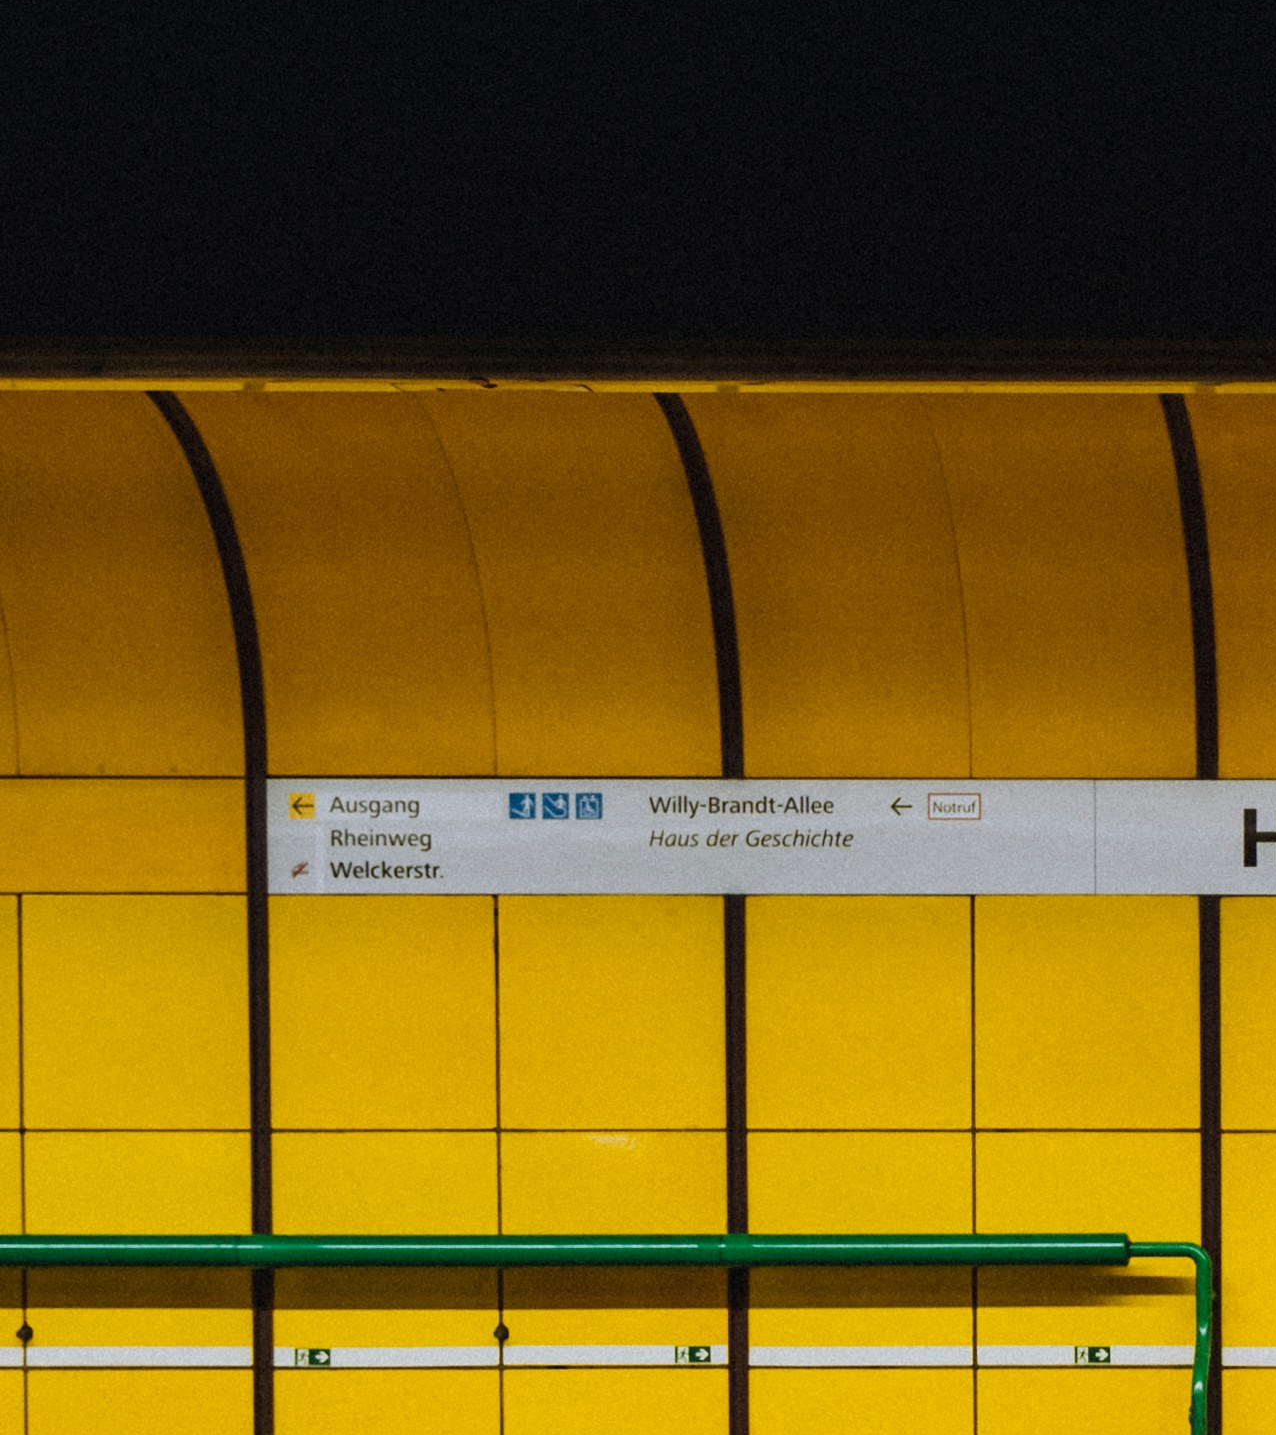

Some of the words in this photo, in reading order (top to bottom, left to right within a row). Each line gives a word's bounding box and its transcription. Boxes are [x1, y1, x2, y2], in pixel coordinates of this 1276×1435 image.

[330, 796, 420, 818] Ausgang
[649, 796, 835, 818] Willy-Brandt-Allee
[932, 800, 976, 814] Notruf
[330, 829, 432, 851] Rheinweg
[650, 830, 699, 847] Haus
[706, 830, 738, 847] der
[746, 829, 854, 848] Geschichte
[330, 861, 444, 880] Welckerstr.
